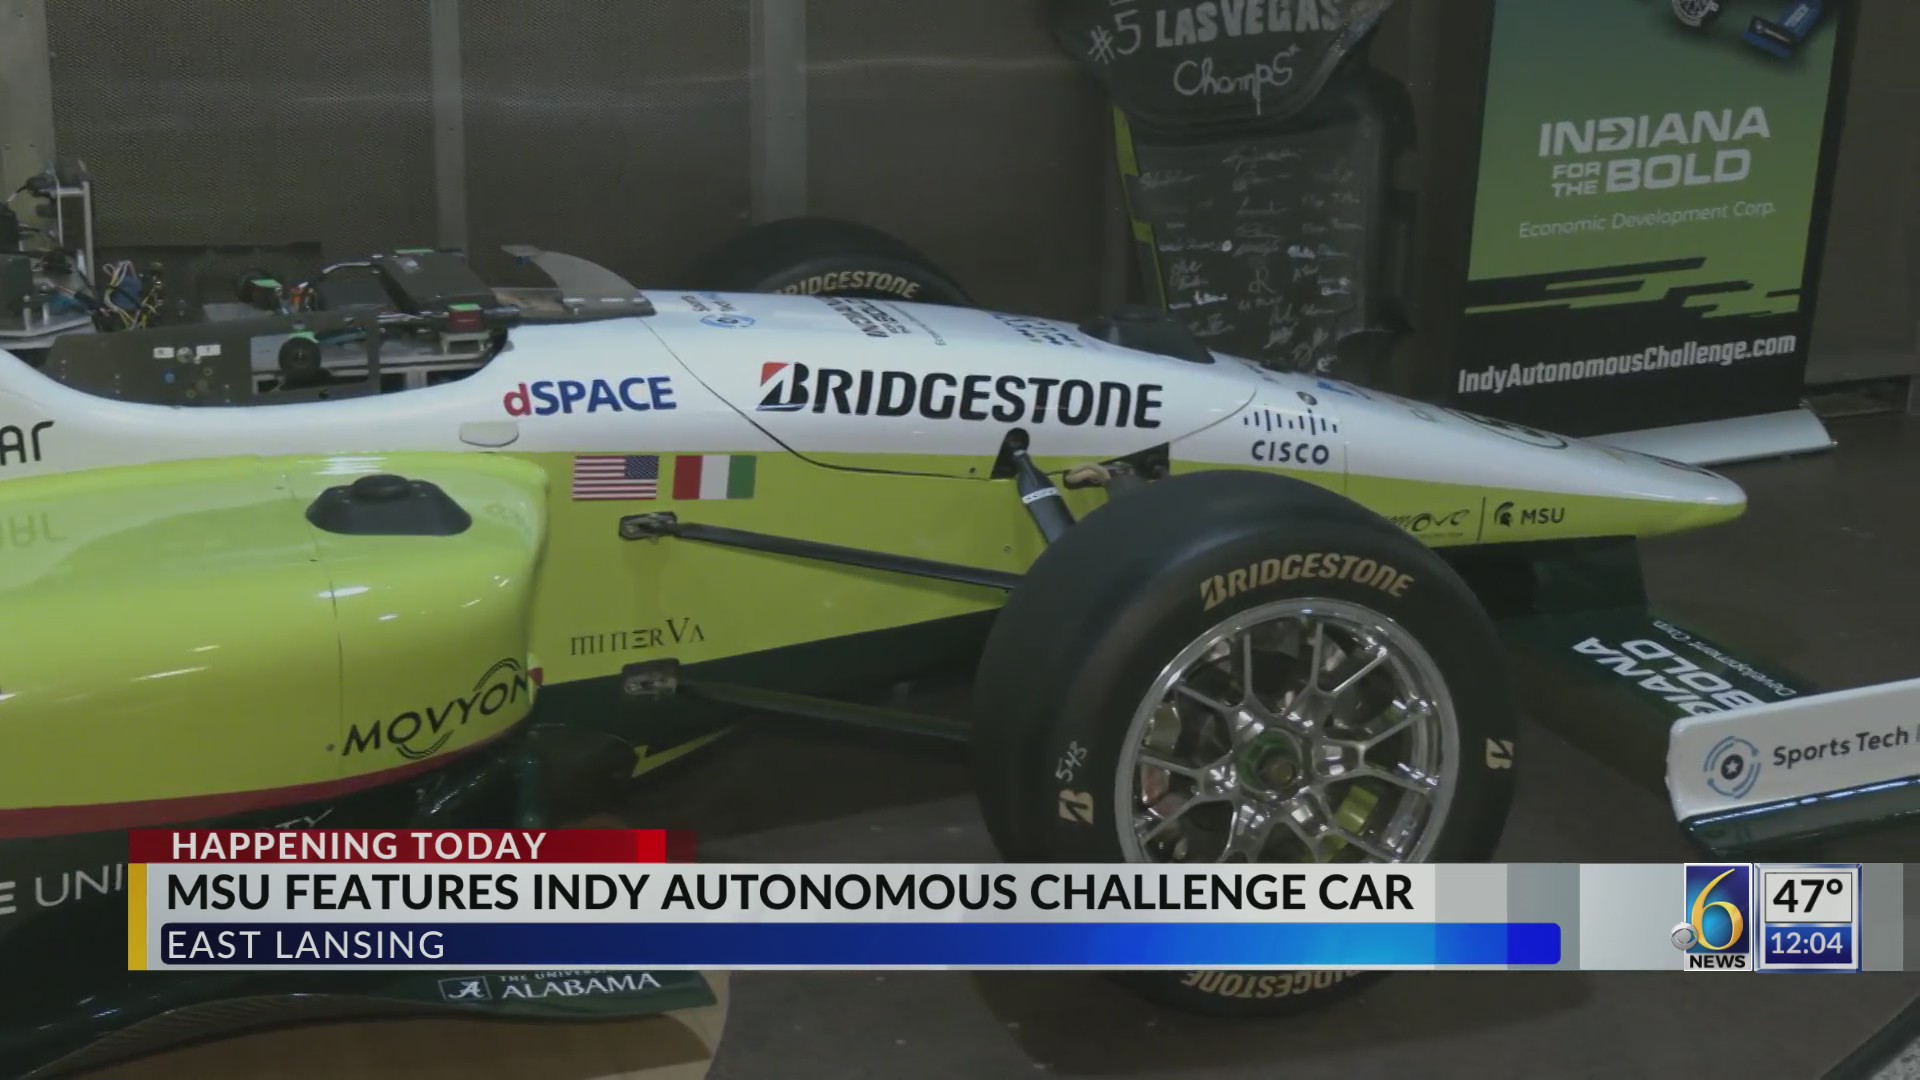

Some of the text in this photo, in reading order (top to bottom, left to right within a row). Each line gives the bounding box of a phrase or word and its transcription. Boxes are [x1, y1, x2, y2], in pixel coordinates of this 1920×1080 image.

[1539, 106, 1770, 156] INDIANA
[1551, 149, 1751, 198] THE BOLD
[1552, 161, 1602, 179] FOR
[1519, 201, 1777, 239] Economic Development Corp.
[777, 271, 920, 298] RIDGESTONE
[1458, 334, 1797, 393] IndyAutonomousChallenge.com
[503, 376, 677, 416] dSPACE
[757, 362, 1164, 428] BRIDGESTONE
[1251, 439, 1330, 465] CISCO
[1521, 507, 1566, 525] MSU
[1202, 552, 1415, 612] BRIDGESTONE
[342, 671, 532, 758] MOVYON
[1773, 737, 1851, 770] Sports
[1855, 725, 1909, 751] Tech
[502, 972, 662, 998] ALABAMA
